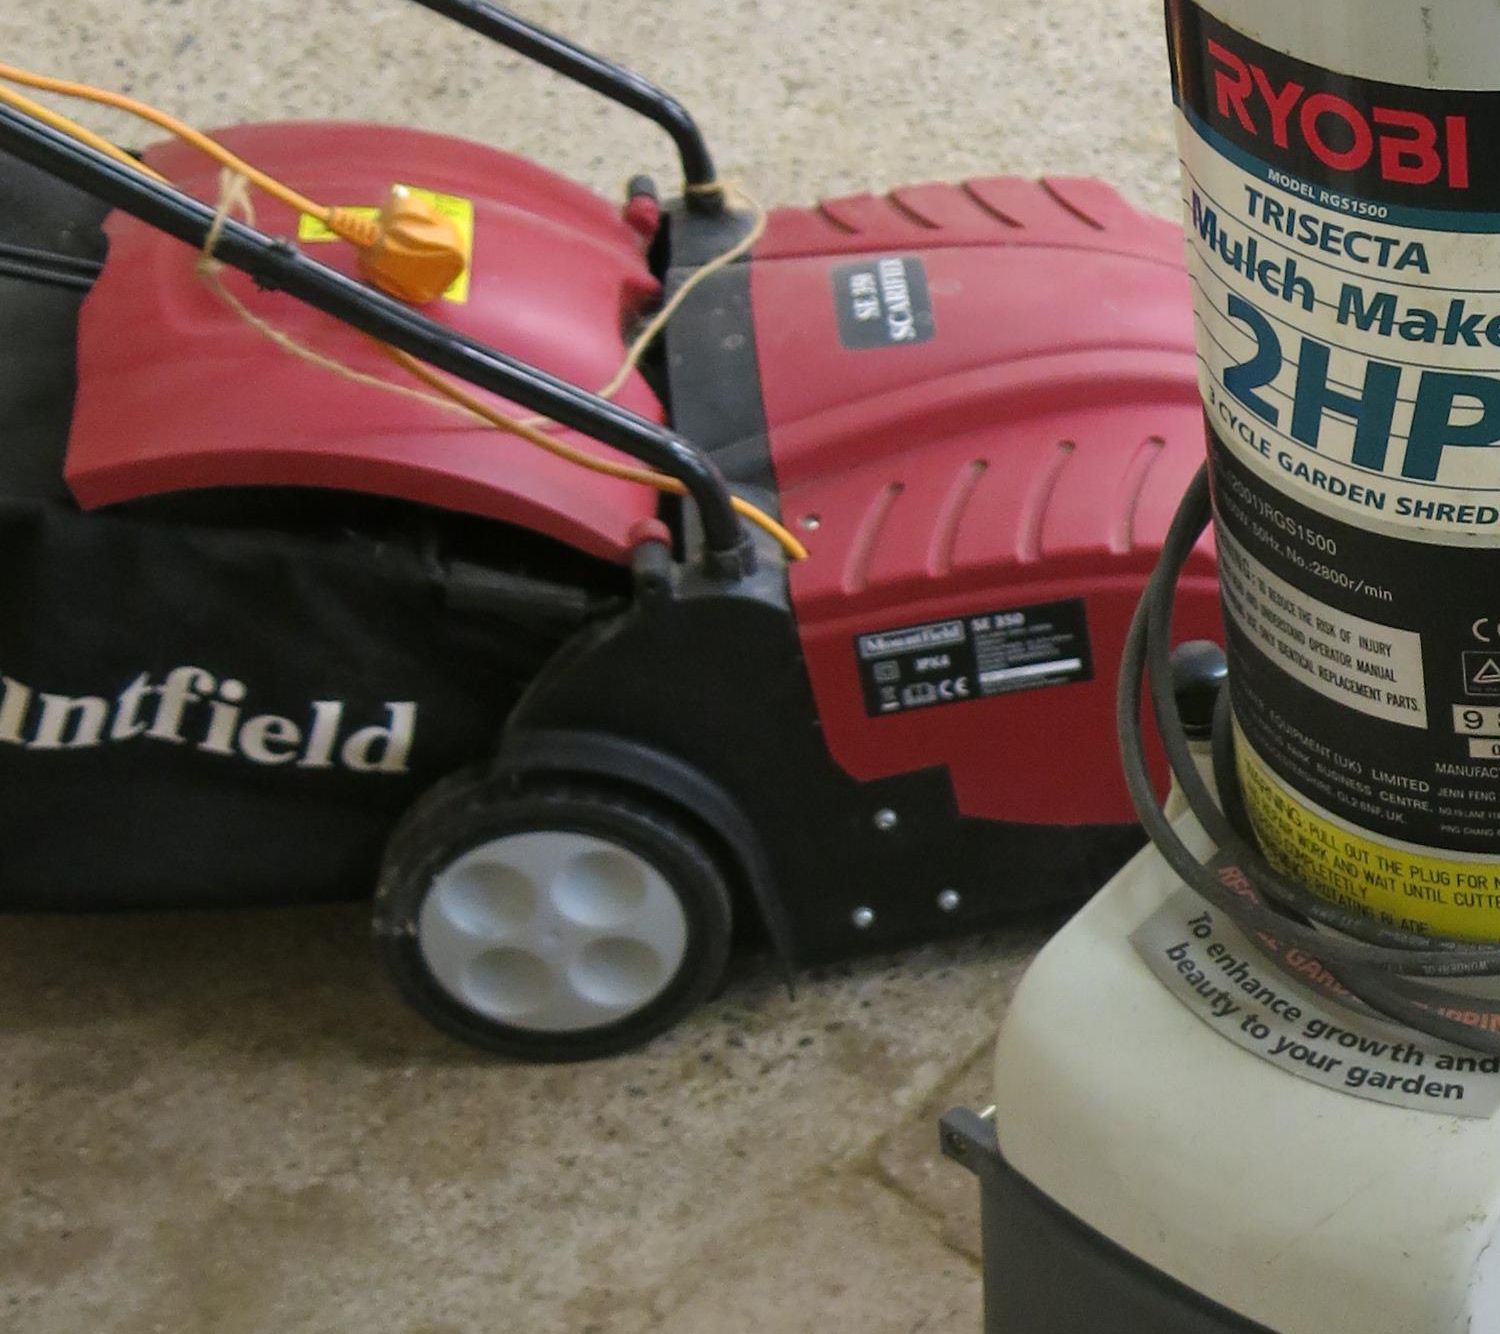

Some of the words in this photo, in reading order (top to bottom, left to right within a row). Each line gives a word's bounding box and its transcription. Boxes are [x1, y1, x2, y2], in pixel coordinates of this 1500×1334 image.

[1208, 39, 1469, 188] RYOBI
[1267, 169, 1316, 199] MODEL
[1319, 189, 1388, 219] RGS1500
[1191, 189, 1316, 312] Mulch
[1244, 185, 1431, 274] TRISECTA
[1219, 401, 1271, 459] CYCLE
[1277, 448, 1386, 510] GARDEN
[1309, 637, 1352, 670] OPERATOR
[1356, 659, 1397, 683] MANUAL
[1315, 617, 1337, 637] RISK
[1339, 627, 1352, 643] OF
[1358, 635, 1393, 657] INJURY
[1318, 664, 1382, 703] REPLACEMENT
[1316, 762, 1372, 796] BUSINESS
[1334, 752, 1362, 774] (UK)
[1371, 768, 1430, 793] LIMITED
[1437, 787, 1465, 800] JENN
[1468, 788, 1496, 802] FENG
[1309, 822, 1340, 852] PULL
[1344, 845, 1370, 864] OUT
[1377, 856, 1404, 876] THE
[1410, 865, 1450, 885] PLUG
[1457, 873, 1488, 889] FOR
[1333, 857, 1359, 877] AND
[1363, 869, 1397, 891] WAIT
[1403, 882, 1448, 904] UNTIL
[1188, 911, 1212, 939] To
[1206, 942, 1302, 1022] enhance
[1302, 1018, 1424, 1066] growth
[1435, 1054, 1500, 1073] and
[1166, 941, 1241, 1017] beauty
[1241, 1013, 1270, 1040] to
[1265, 1032, 1341, 1074] your
[1345, 1066, 1464, 1099] garden
